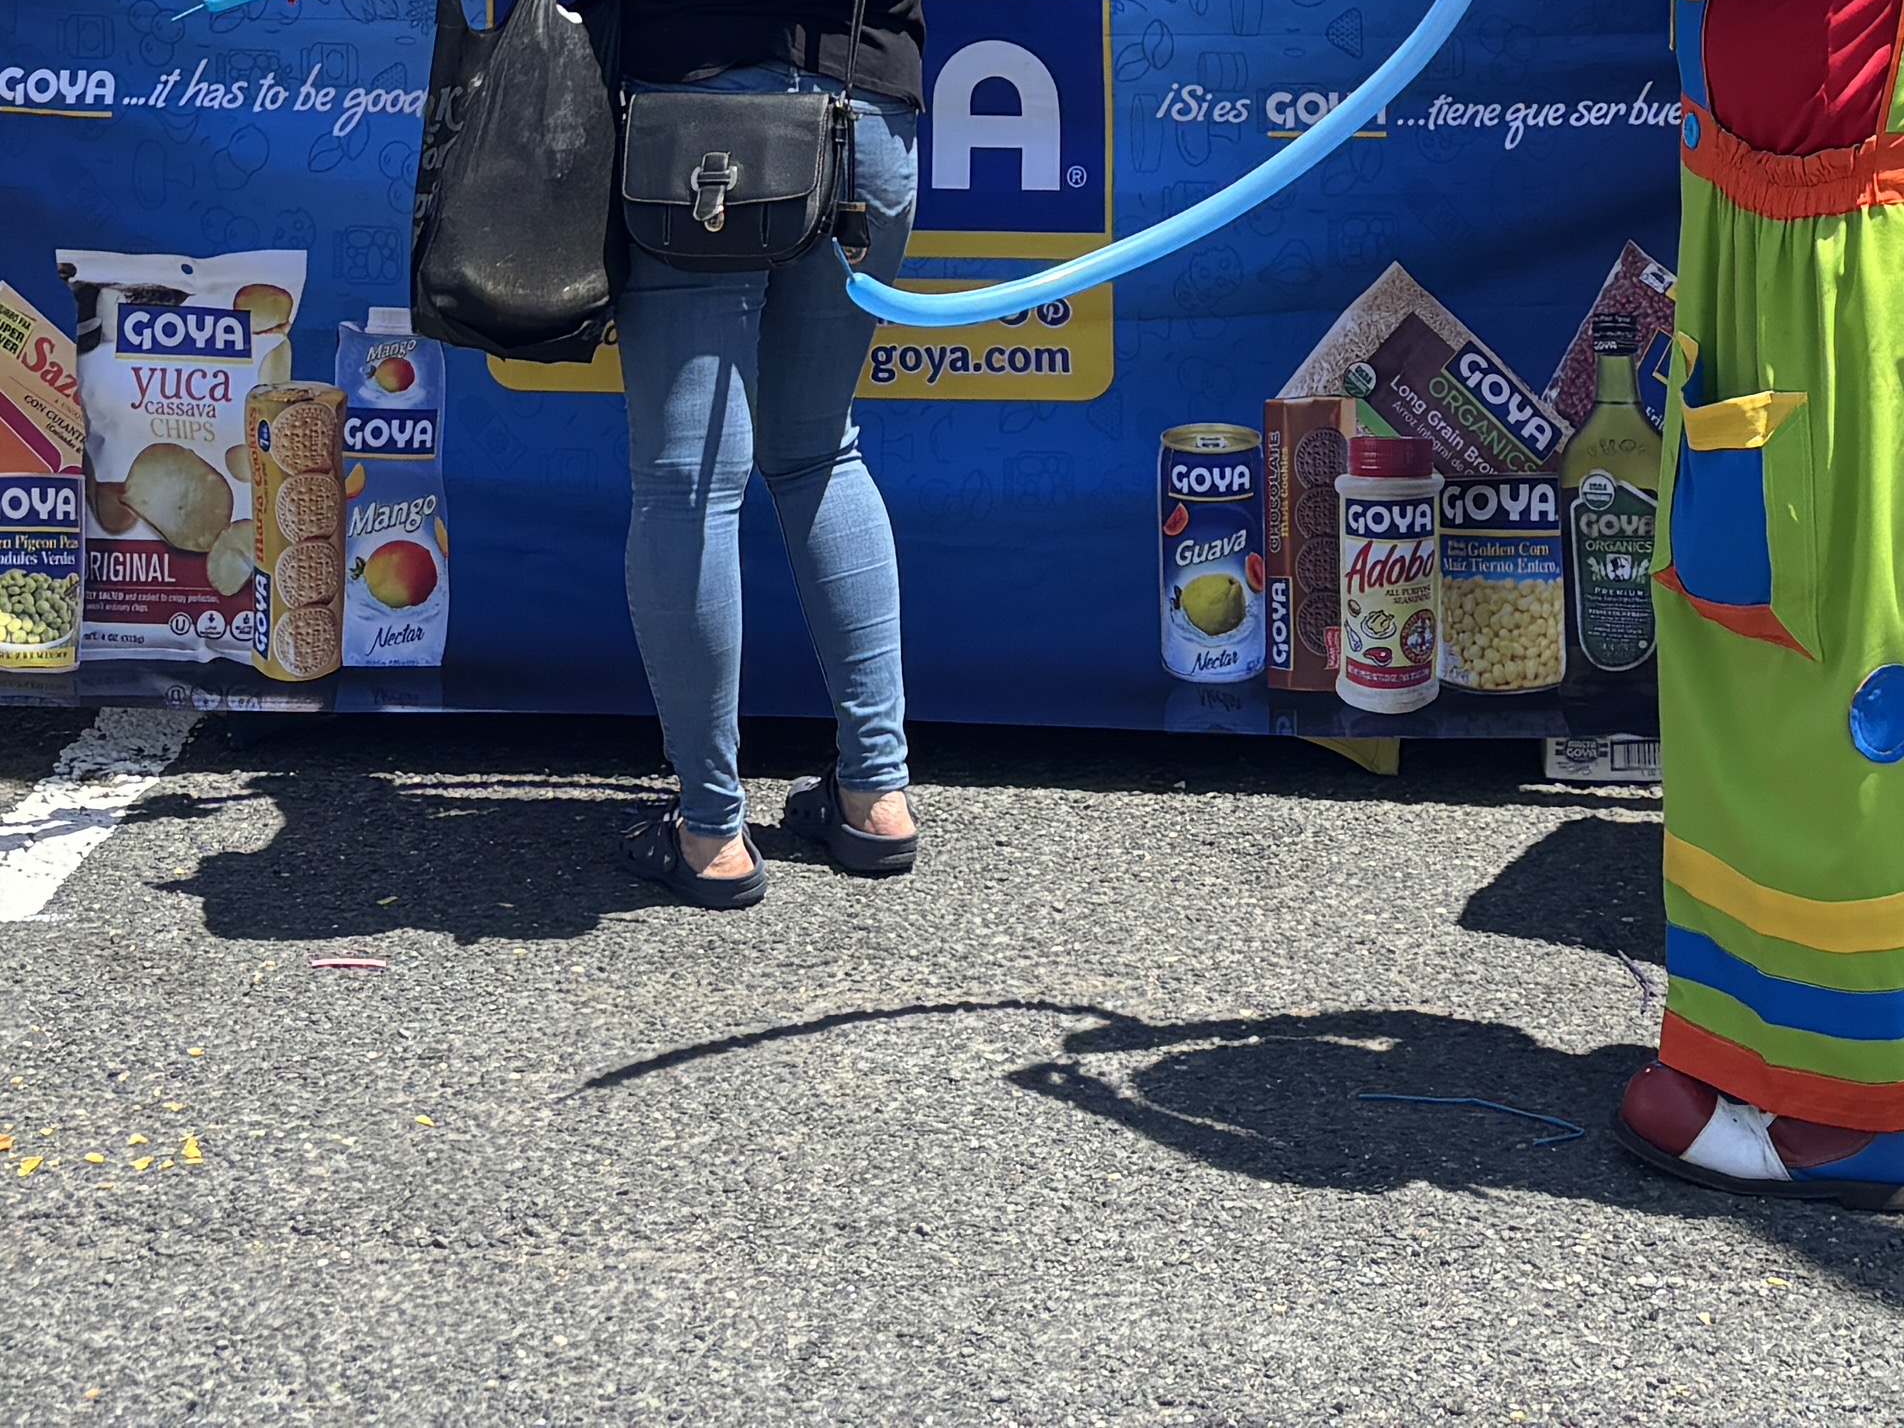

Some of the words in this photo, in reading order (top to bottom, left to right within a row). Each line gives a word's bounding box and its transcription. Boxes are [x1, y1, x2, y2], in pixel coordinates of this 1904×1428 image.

[178, 58, 244, 110] has
[252, 66, 289, 112] to
[293, 63, 334, 113] be
[1266, 91, 1387, 130] GO
[1505, 103, 1565, 150] que
[1569, 100, 1628, 127] ser
[1628, 82, 1683, 128] bue
[123, 310, 245, 351] GOYA
[366, 339, 417, 363] Mango
[871, 339, 1071, 386] goya.com
[130, 365, 233, 411] yuca
[1459, 351, 1554, 452] GOYA
[144, 399, 217, 419] cassava
[1390, 374, 1427, 416] Long
[1427, 410, 1465, 451] Grain
[1428, 376, 1537, 473] ORGANICS
[149, 417, 216, 443] CHIPS
[343, 418, 434, 450] GOYA
[1171, 464, 1251, 494] GOYA
[348, 494, 437, 538] Mango
[1347, 503, 1433, 534] GOYA
[1442, 482, 1555, 525] GOYA
[1579, 511, 1655, 538] GOYA
[14, 536, 55, 552] Pigeon
[1175, 529, 1248, 567] Guava
[1467, 542, 1515, 557] Golden
[1585, 539, 1653, 553] ORGANICS
[1345, 539, 1435, 596] Adobo
[1469, 558, 1514, 573] Tierno
[254, 575, 269, 653] GOYA
[1271, 581, 1286, 664] GOYA
[364, 623, 426, 657] Nectar
[1191, 649, 1239, 674] Nectar
